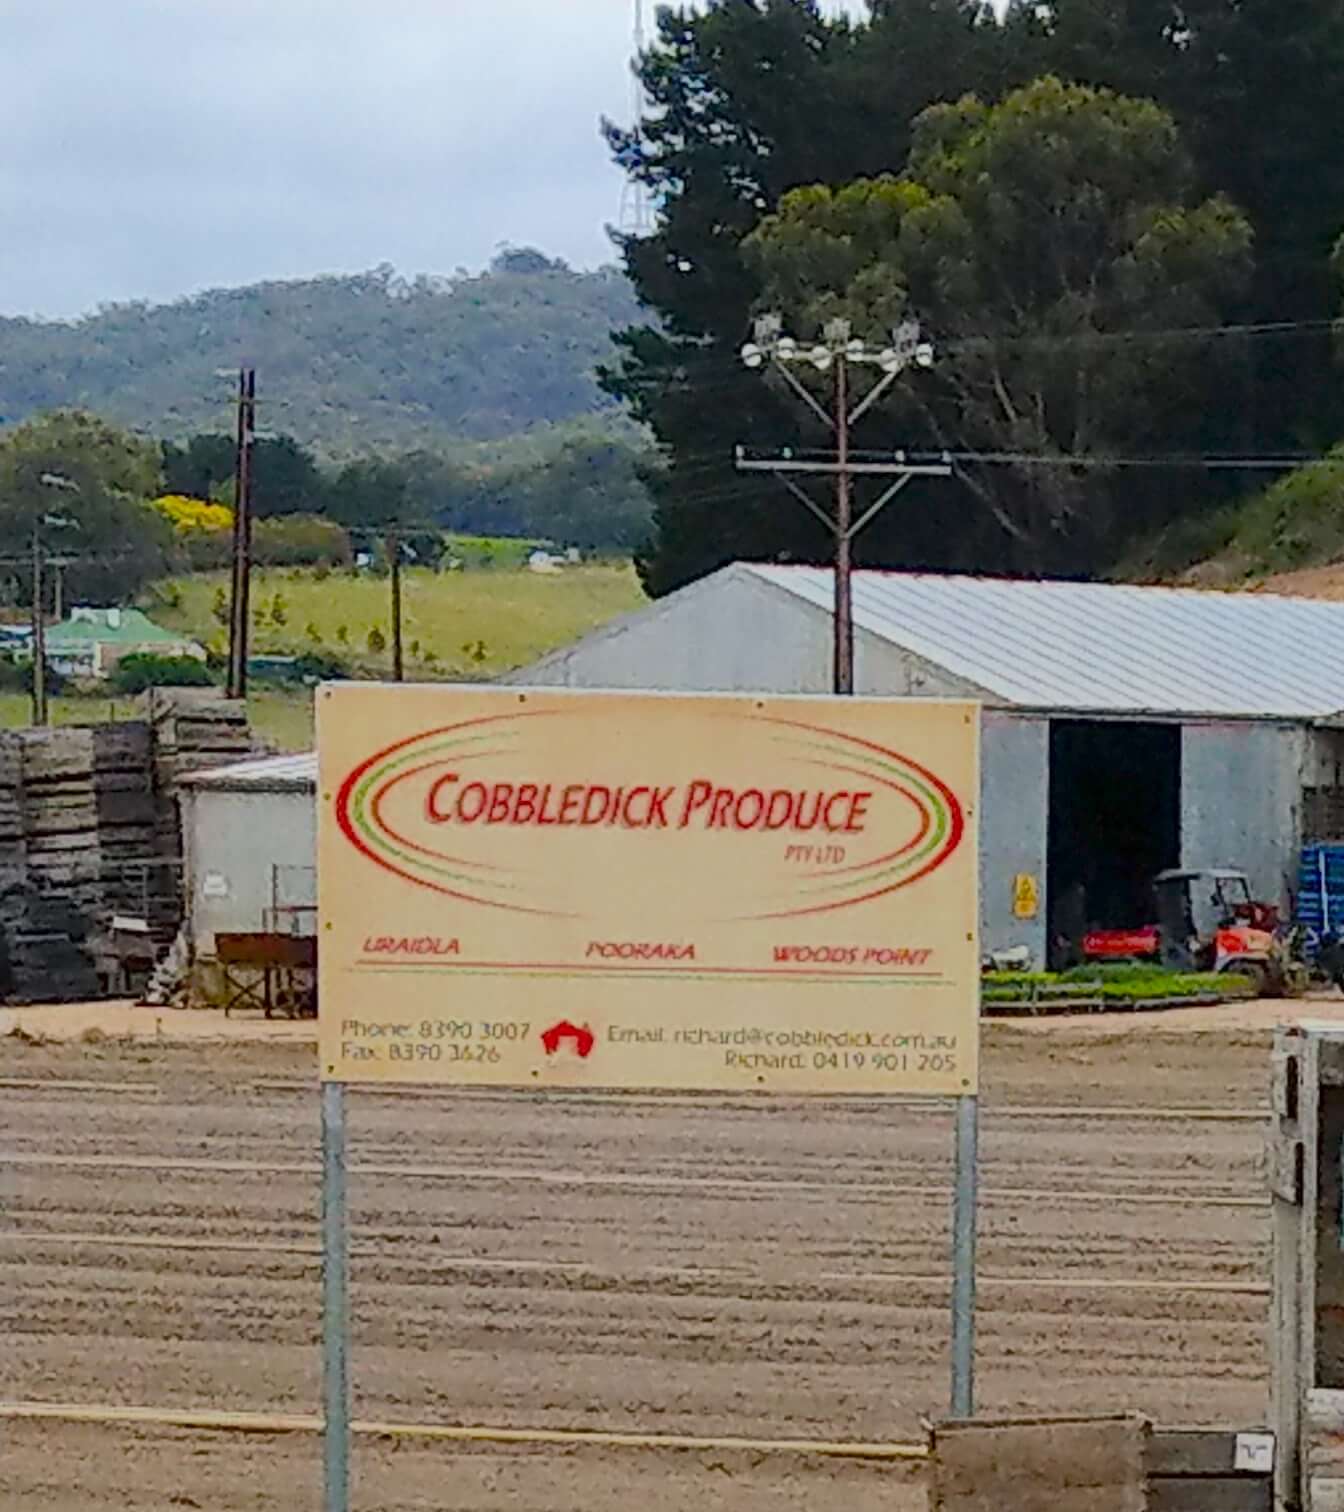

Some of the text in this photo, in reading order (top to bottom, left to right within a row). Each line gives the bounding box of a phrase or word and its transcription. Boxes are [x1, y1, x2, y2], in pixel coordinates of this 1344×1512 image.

[425, 773, 872, 832] COBBLEDICK PRODUCE
[784, 845, 846, 864] PTY LTD
[362, 937, 461, 955] URAIDLA
[585, 942, 697, 961] POORAKA
[773, 946, 933, 966] WOODS POINT
[418, 1020, 472, 1039] 8390
[480, 1021, 531, 1041] 3007
[388, 1043, 441, 1061] 8390
[813, 1052, 865, 1070] 0419
[871, 1053, 907, 1072] 901
